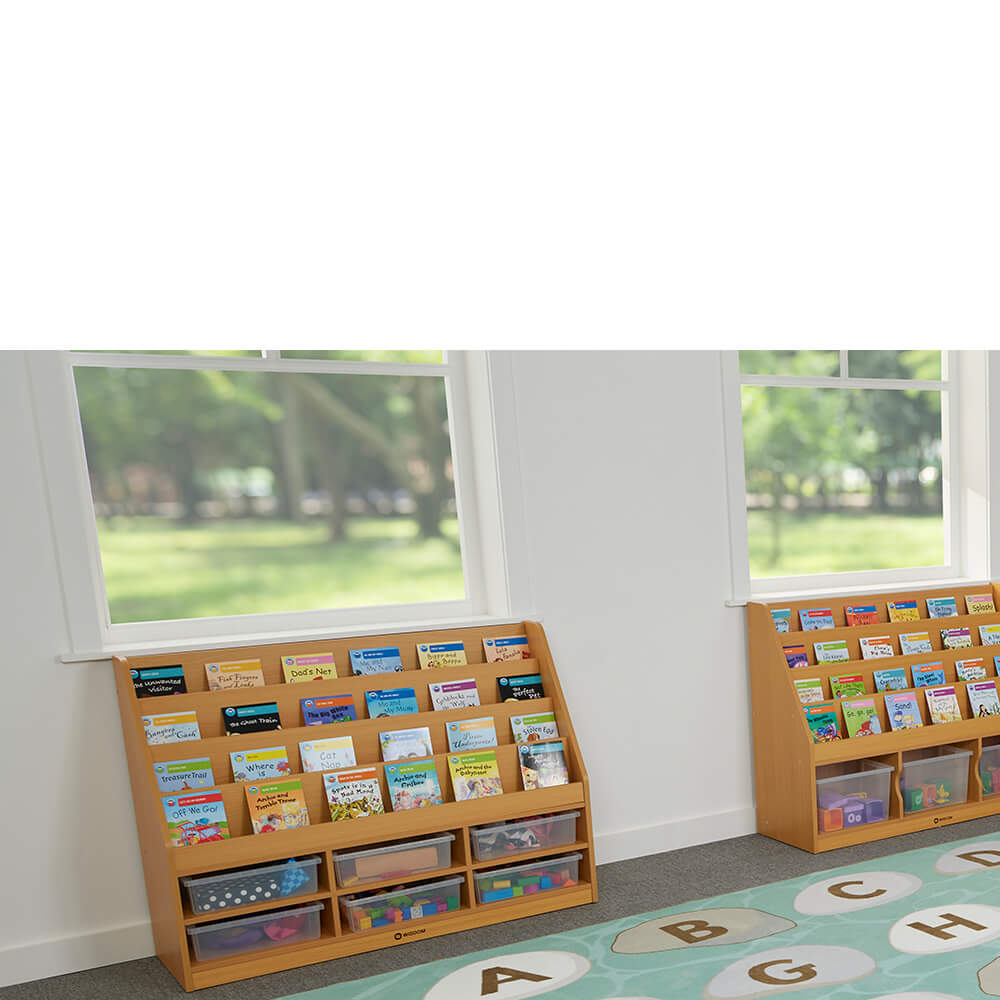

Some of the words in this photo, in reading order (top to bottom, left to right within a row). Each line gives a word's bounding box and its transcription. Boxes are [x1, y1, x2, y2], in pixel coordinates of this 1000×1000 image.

[320, 752, 337, 761] Cat
[161, 774, 192, 783] Treasure
[192, 771, 208, 780] Trail
[246, 761, 275, 773] Where
[173, 808, 187, 819] Off
[190, 806, 201, 815] We
[202, 803, 218, 813] Go!
[827, 880, 886, 900] C
[657, 919, 729, 945] B
[906, 913, 988, 941] H
[481, 967, 553, 996] A
[748, 959, 817, 985] G
